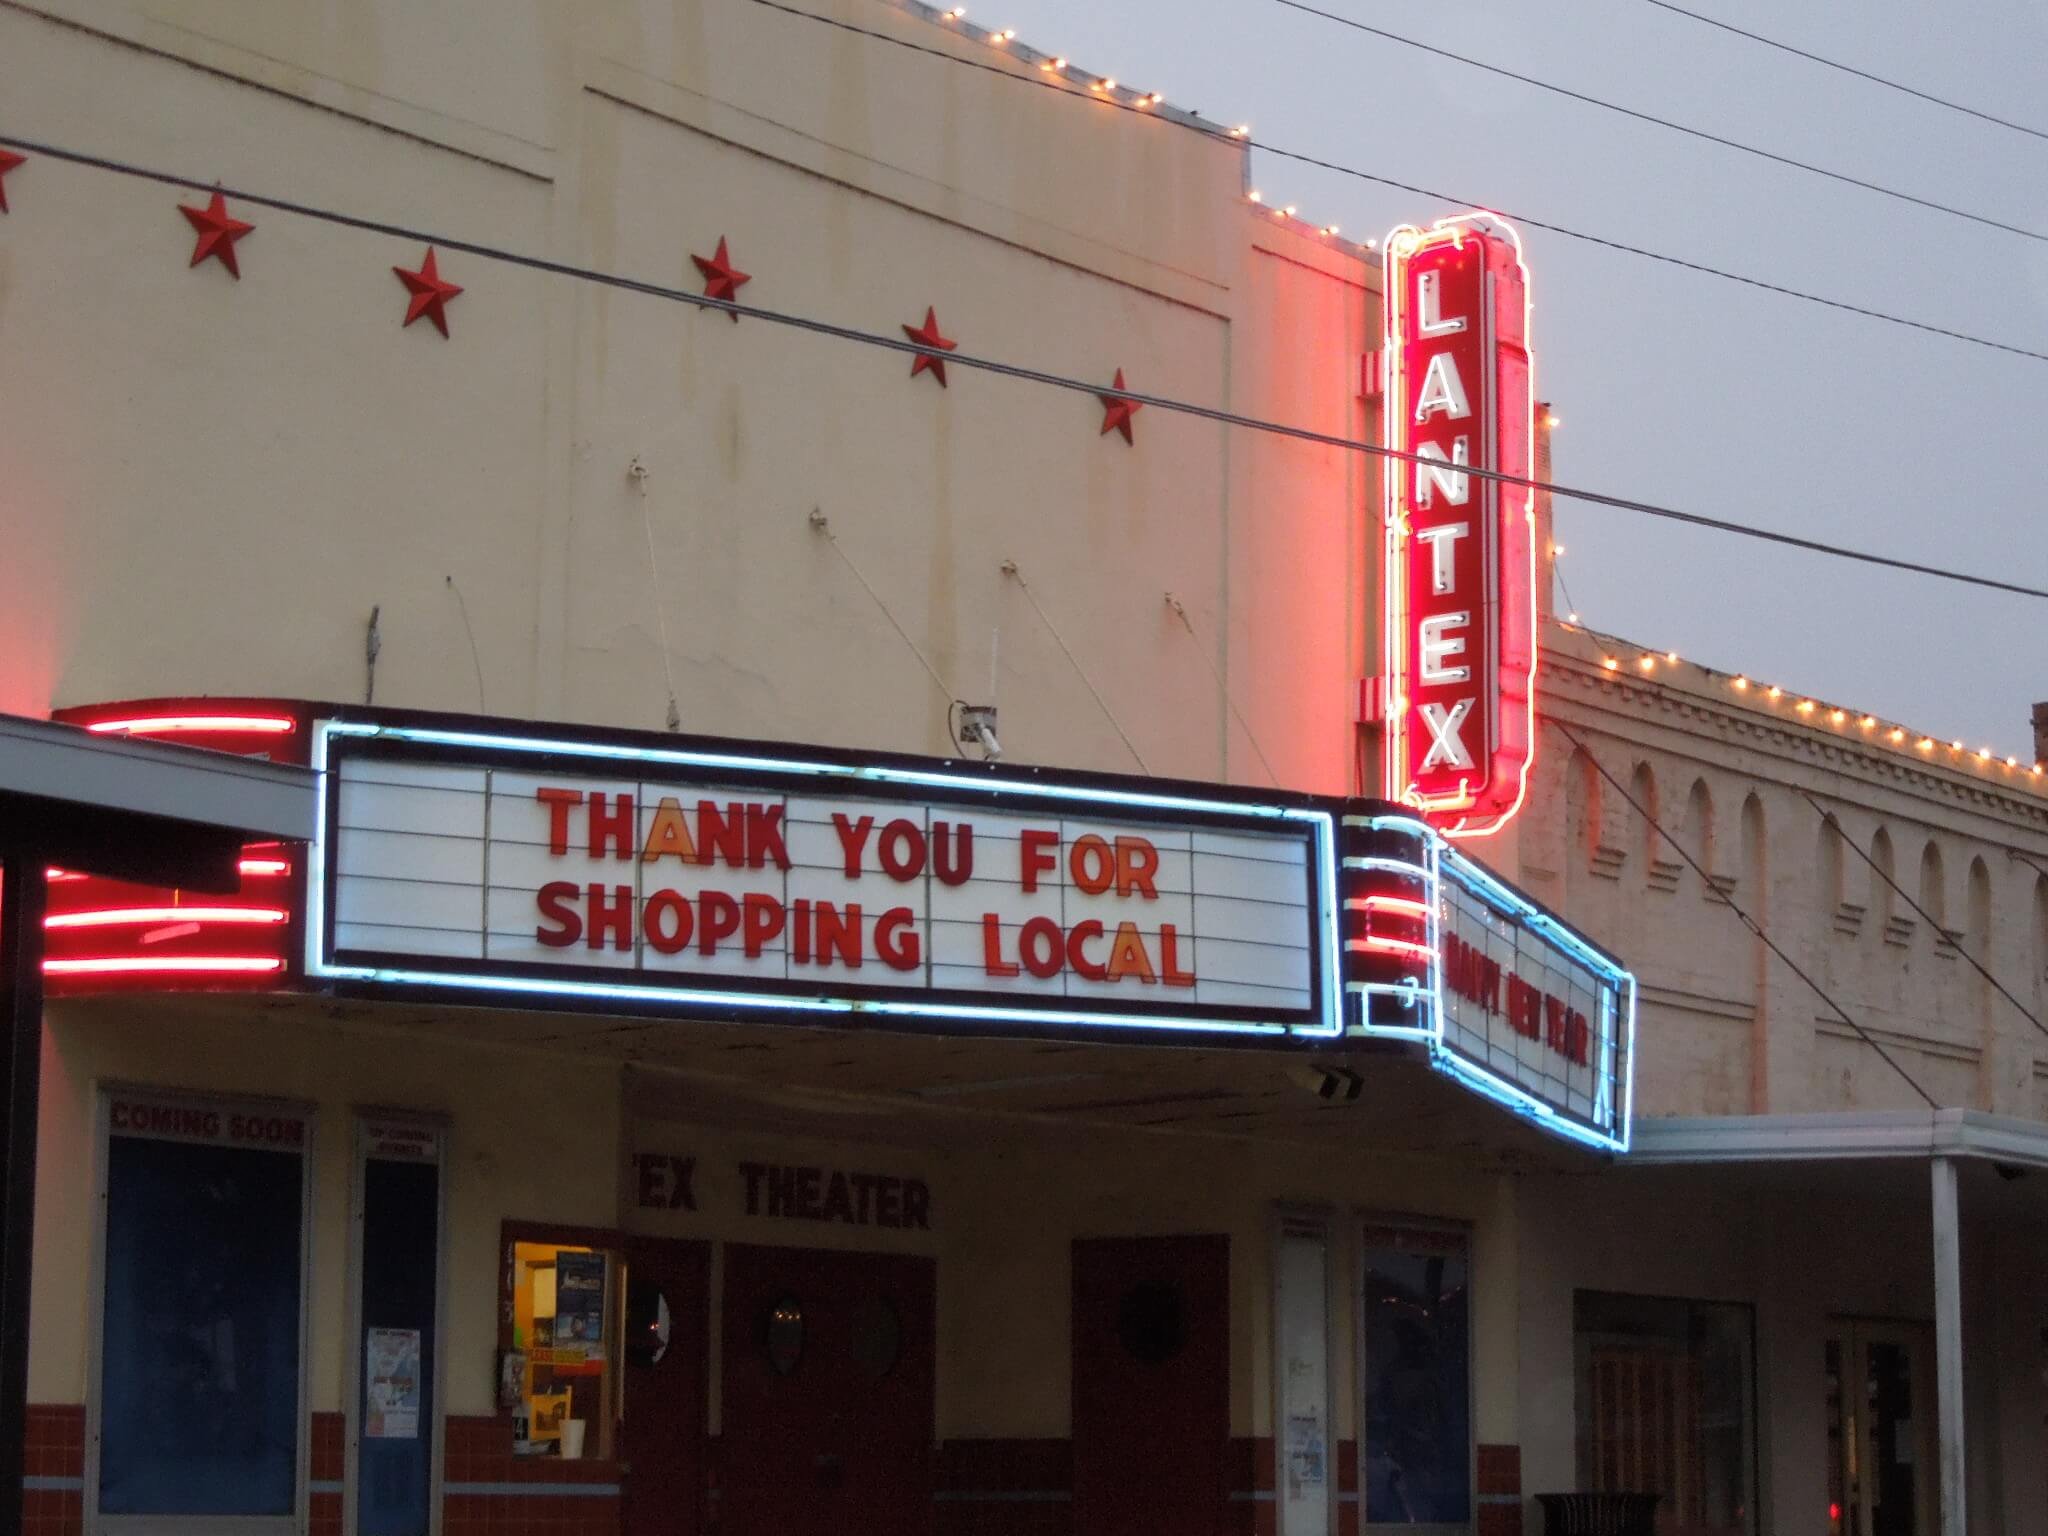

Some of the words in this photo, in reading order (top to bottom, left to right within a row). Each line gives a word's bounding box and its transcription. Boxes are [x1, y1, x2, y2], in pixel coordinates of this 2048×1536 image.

[1415, 268, 1477, 775] LANTEX
[537, 787, 792, 870] THANK
[831, 812, 973, 885] YOU
[1020, 829, 1159, 899] FOR
[536, 881, 920, 971] SHOPPING
[982, 912, 1195, 987] LOCAL
[110, 1099, 221, 1139] COMING
[230, 1113, 305, 1148] SOON
[632, 1153, 698, 1211] EX
[738, 1160, 932, 1230] THEATER
